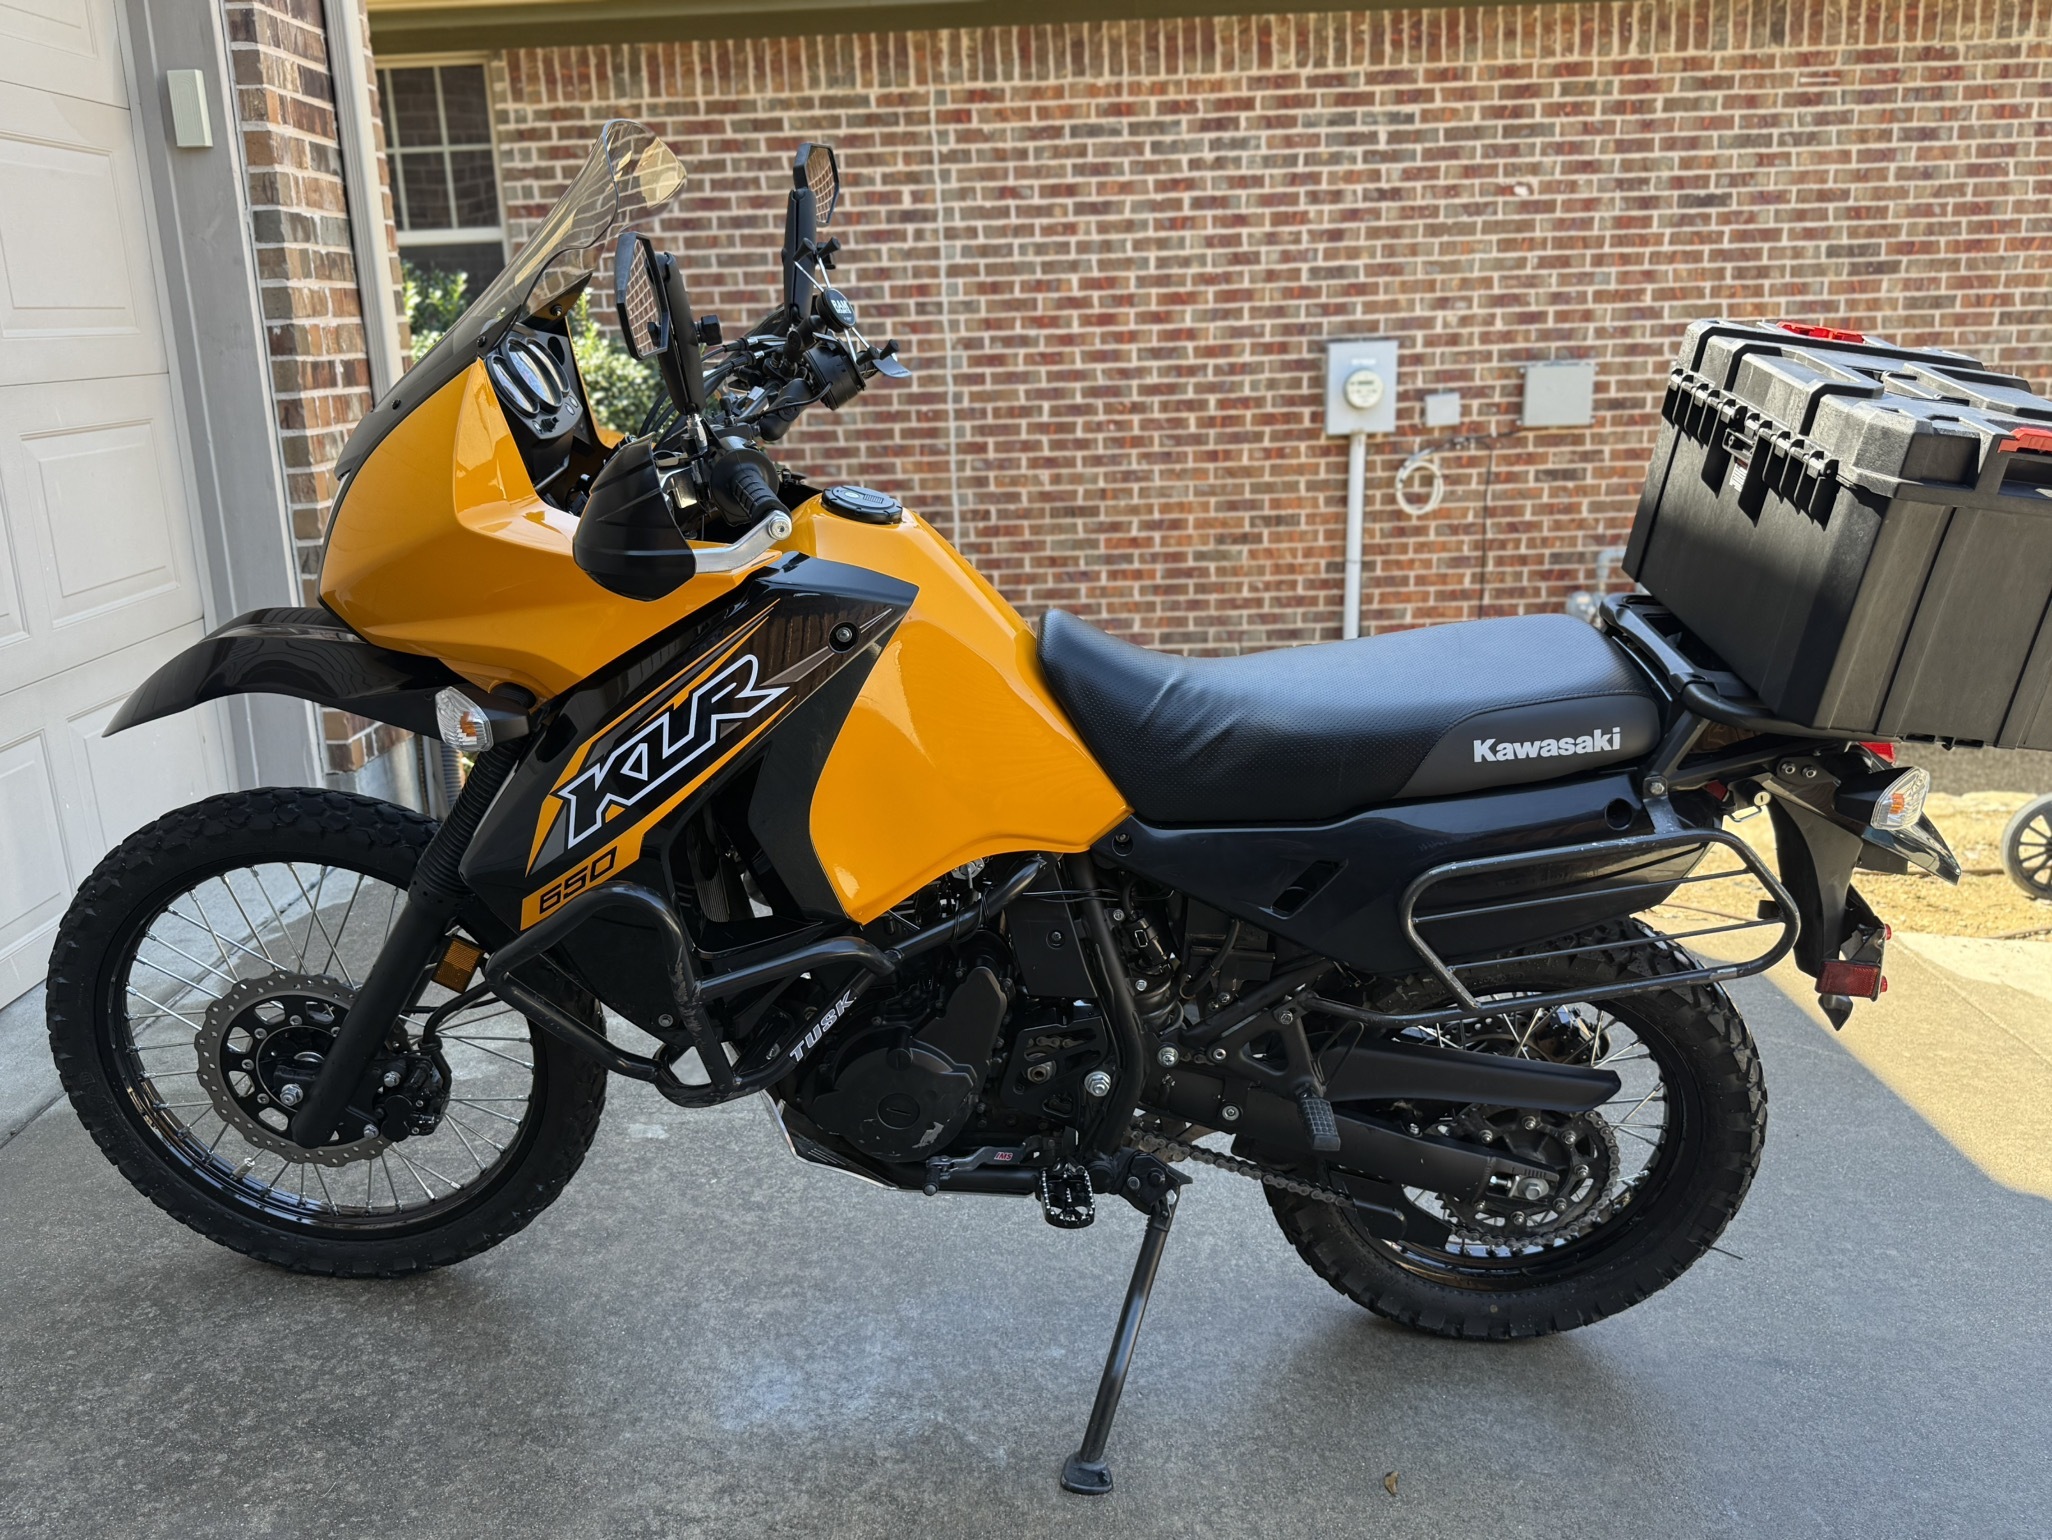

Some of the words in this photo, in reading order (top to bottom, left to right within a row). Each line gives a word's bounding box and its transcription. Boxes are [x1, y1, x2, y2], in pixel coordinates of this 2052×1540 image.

[557, 654, 790, 849] KLR
[1473, 726, 1621, 763] Kawasaki
[539, 845, 618, 915] 650
[789, 988, 855, 1062] TUSK
